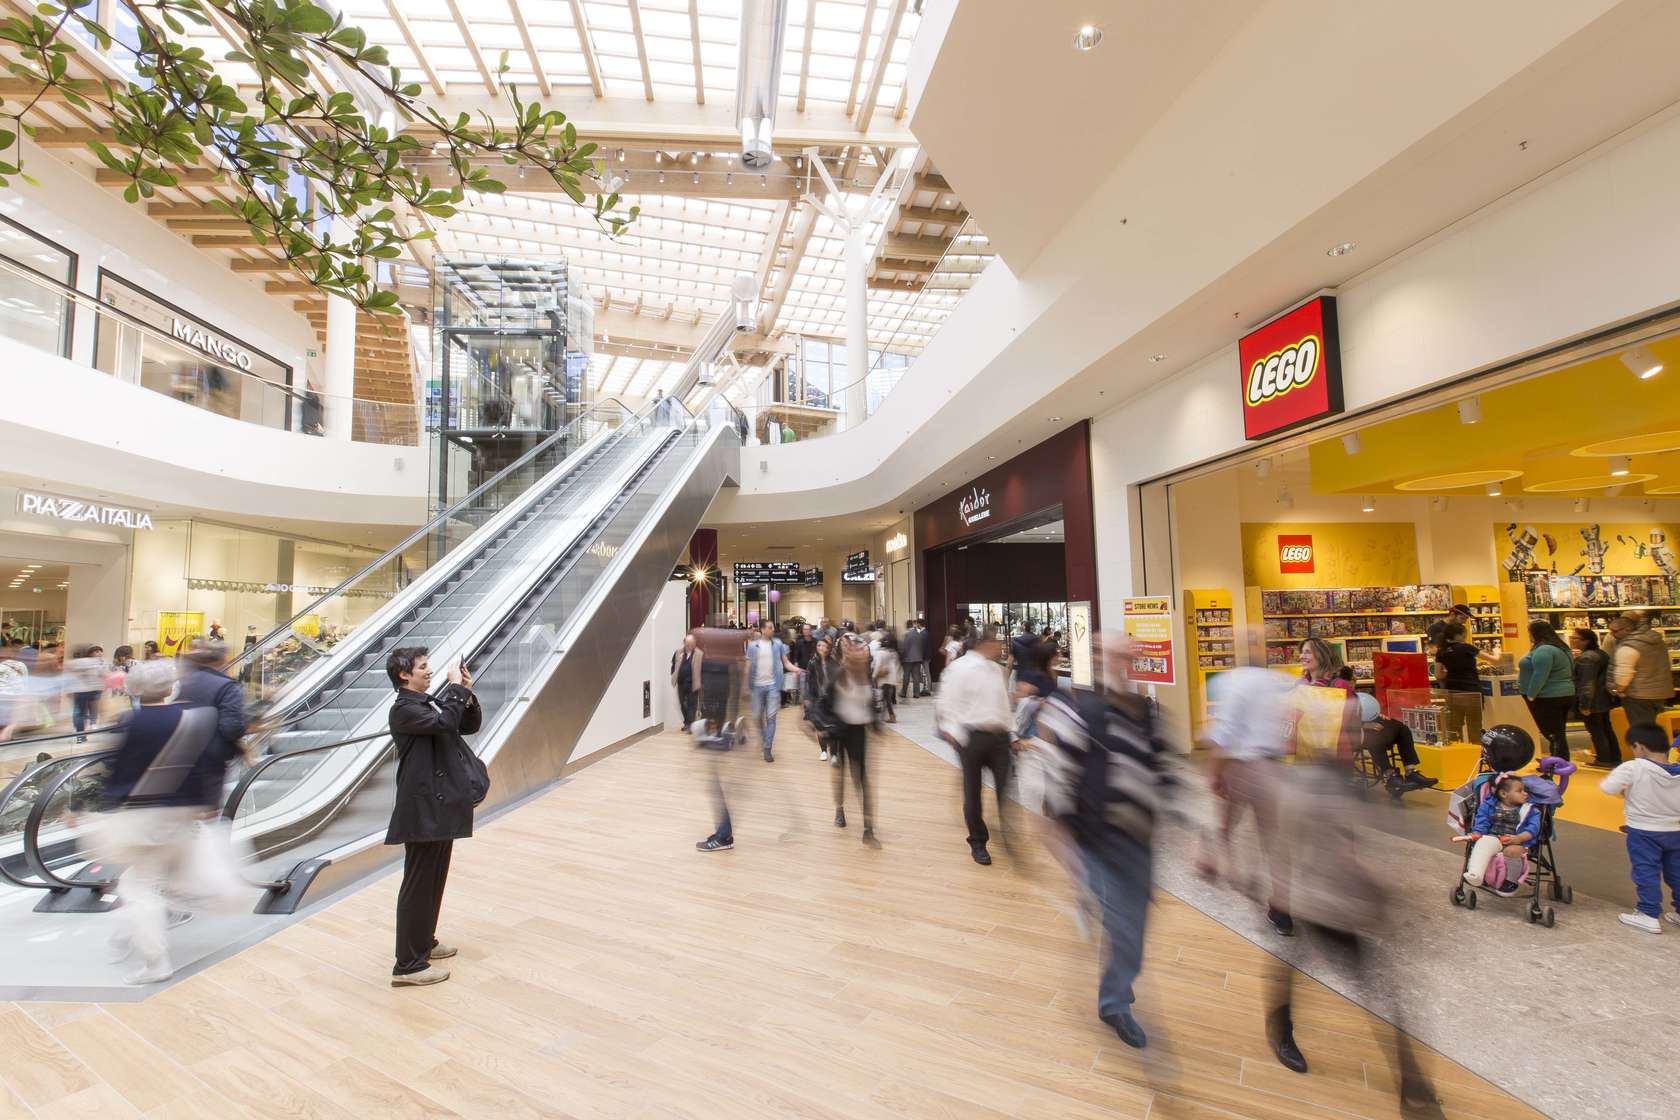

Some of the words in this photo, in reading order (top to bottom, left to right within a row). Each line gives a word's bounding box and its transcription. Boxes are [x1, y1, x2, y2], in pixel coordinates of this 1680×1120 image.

[173, 318, 251, 370] MANGO
[1248, 337, 1319, 405] LEGO
[23, 494, 100, 522] PIAZZA
[101, 507, 153, 530] ITALIA
[1281, 546, 1312, 562] LEGO
